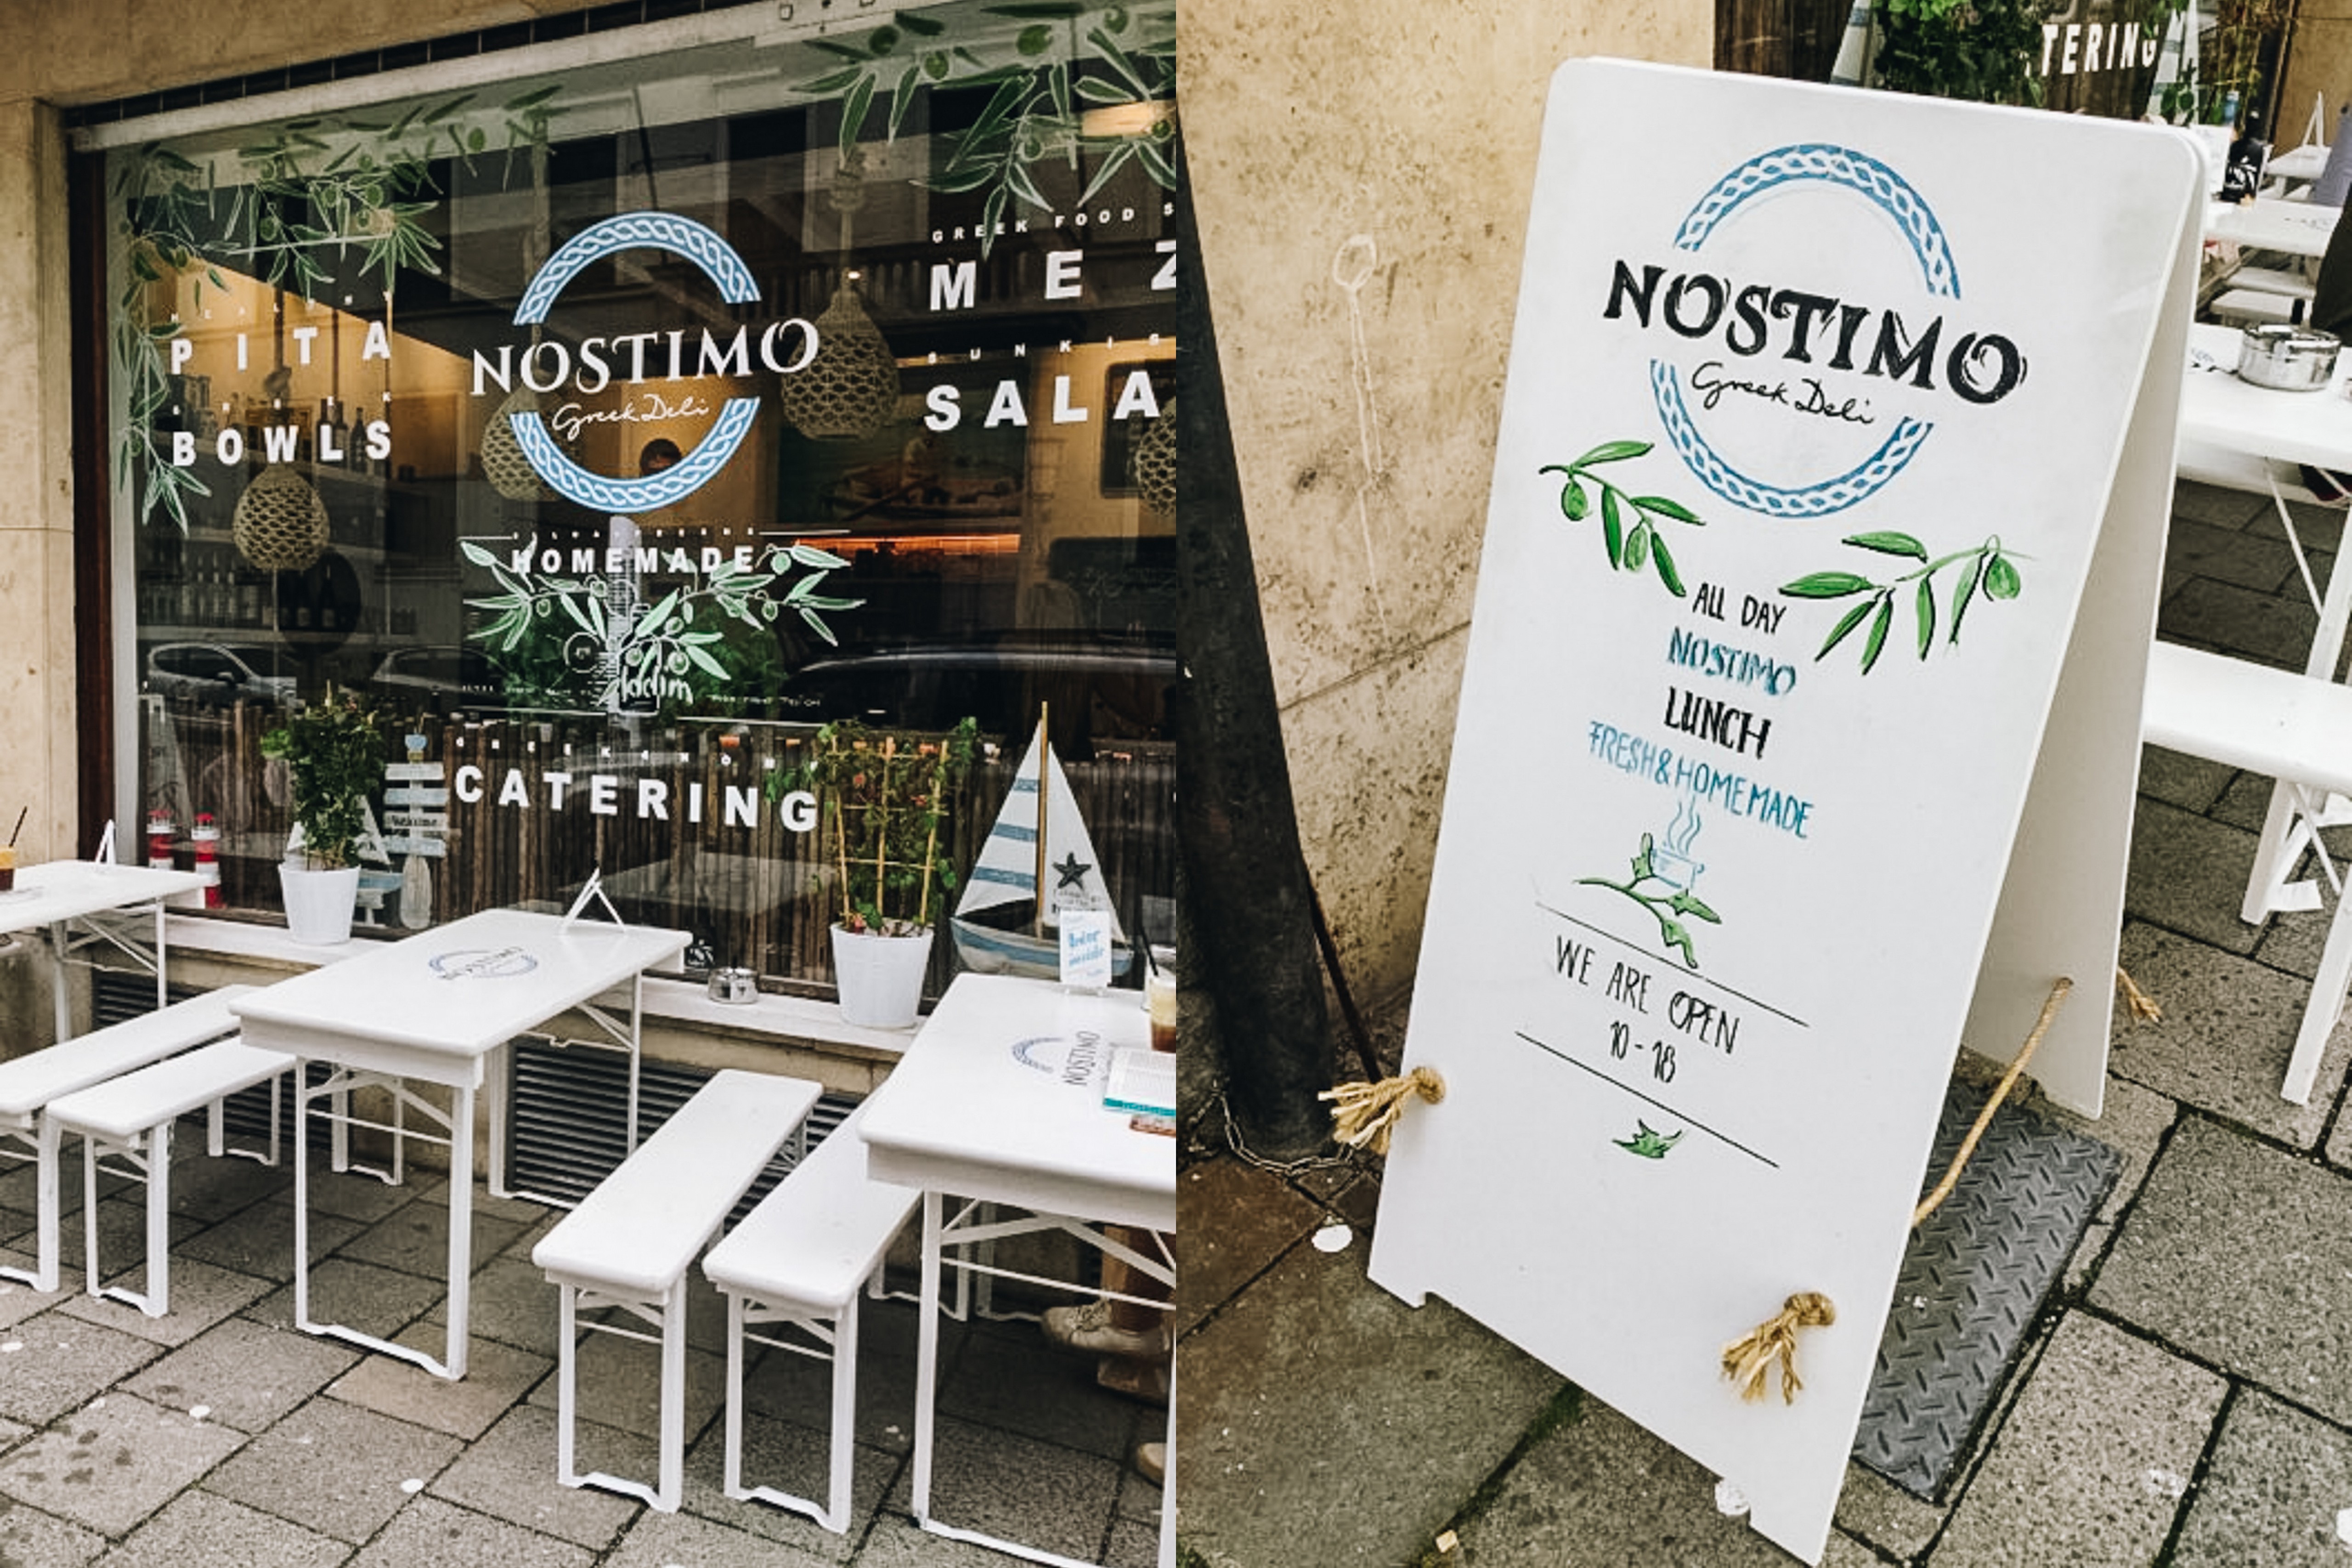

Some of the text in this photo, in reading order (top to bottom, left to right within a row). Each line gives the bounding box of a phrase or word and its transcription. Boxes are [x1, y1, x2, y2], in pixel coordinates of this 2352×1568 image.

[933, 220, 1027, 243] GREEK
[1055, 208, 1135, 228] FOOD
[171, 320, 391, 374] PITA
[470, 317, 820, 396] NOSTIMO
[1603, 259, 2028, 404] NOSTIMO
[551, 394, 710, 441] Greek Deli
[924, 370, 1160, 431] SALA
[1691, 362, 1874, 425] Greek Deli
[173, 420, 391, 466] BOWLS
[512, 545, 753, 573] HOMEMADE
[1692, 582, 1787, 634] ALL DAY
[1667, 626, 1796, 696] NOSTIMO
[1664, 686, 1771, 759] LUNCH
[455, 765, 817, 832] CATERING
[1556, 935, 1740, 1054] WE ARE OPEN
